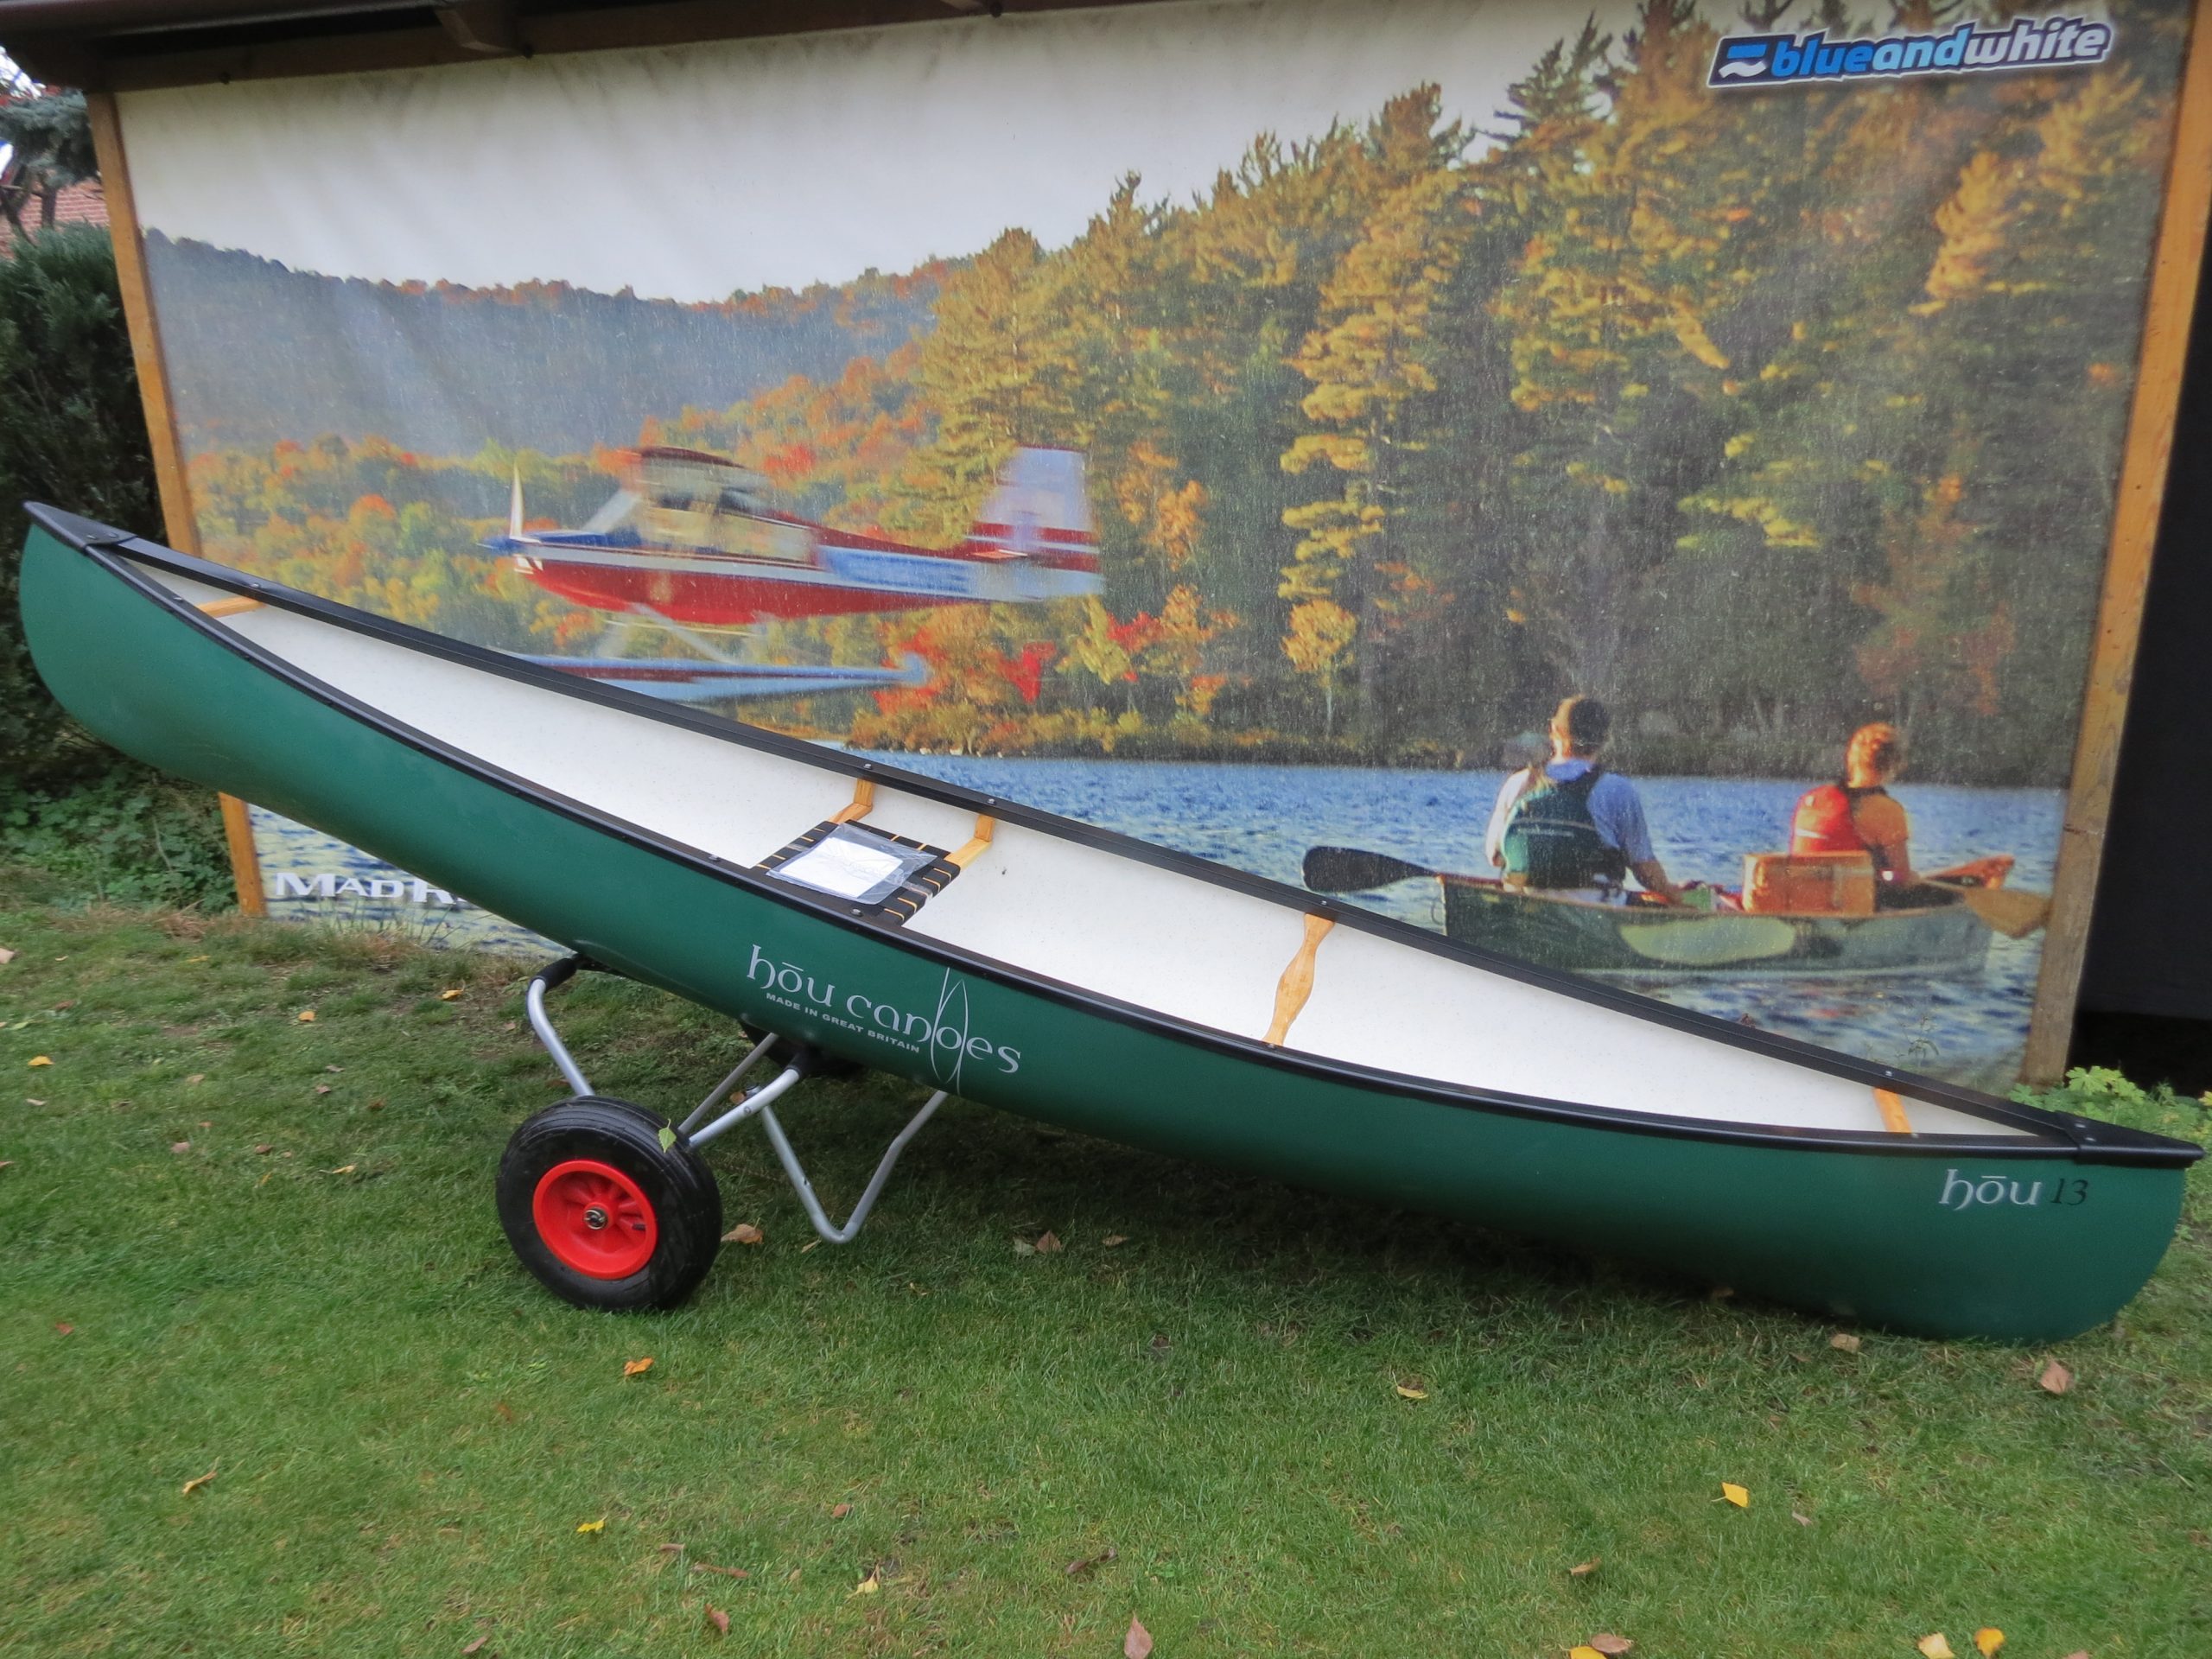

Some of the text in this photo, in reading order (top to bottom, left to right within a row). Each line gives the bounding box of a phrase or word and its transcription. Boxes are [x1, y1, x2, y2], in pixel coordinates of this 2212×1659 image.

[1770, 22, 2108, 78] blueandwhite
[766, 992, 920, 1053] MADE IN GREAT BRITAIN
[846, 994, 1021, 1074] canoes
[2050, 1178, 2088, 1206] 13
